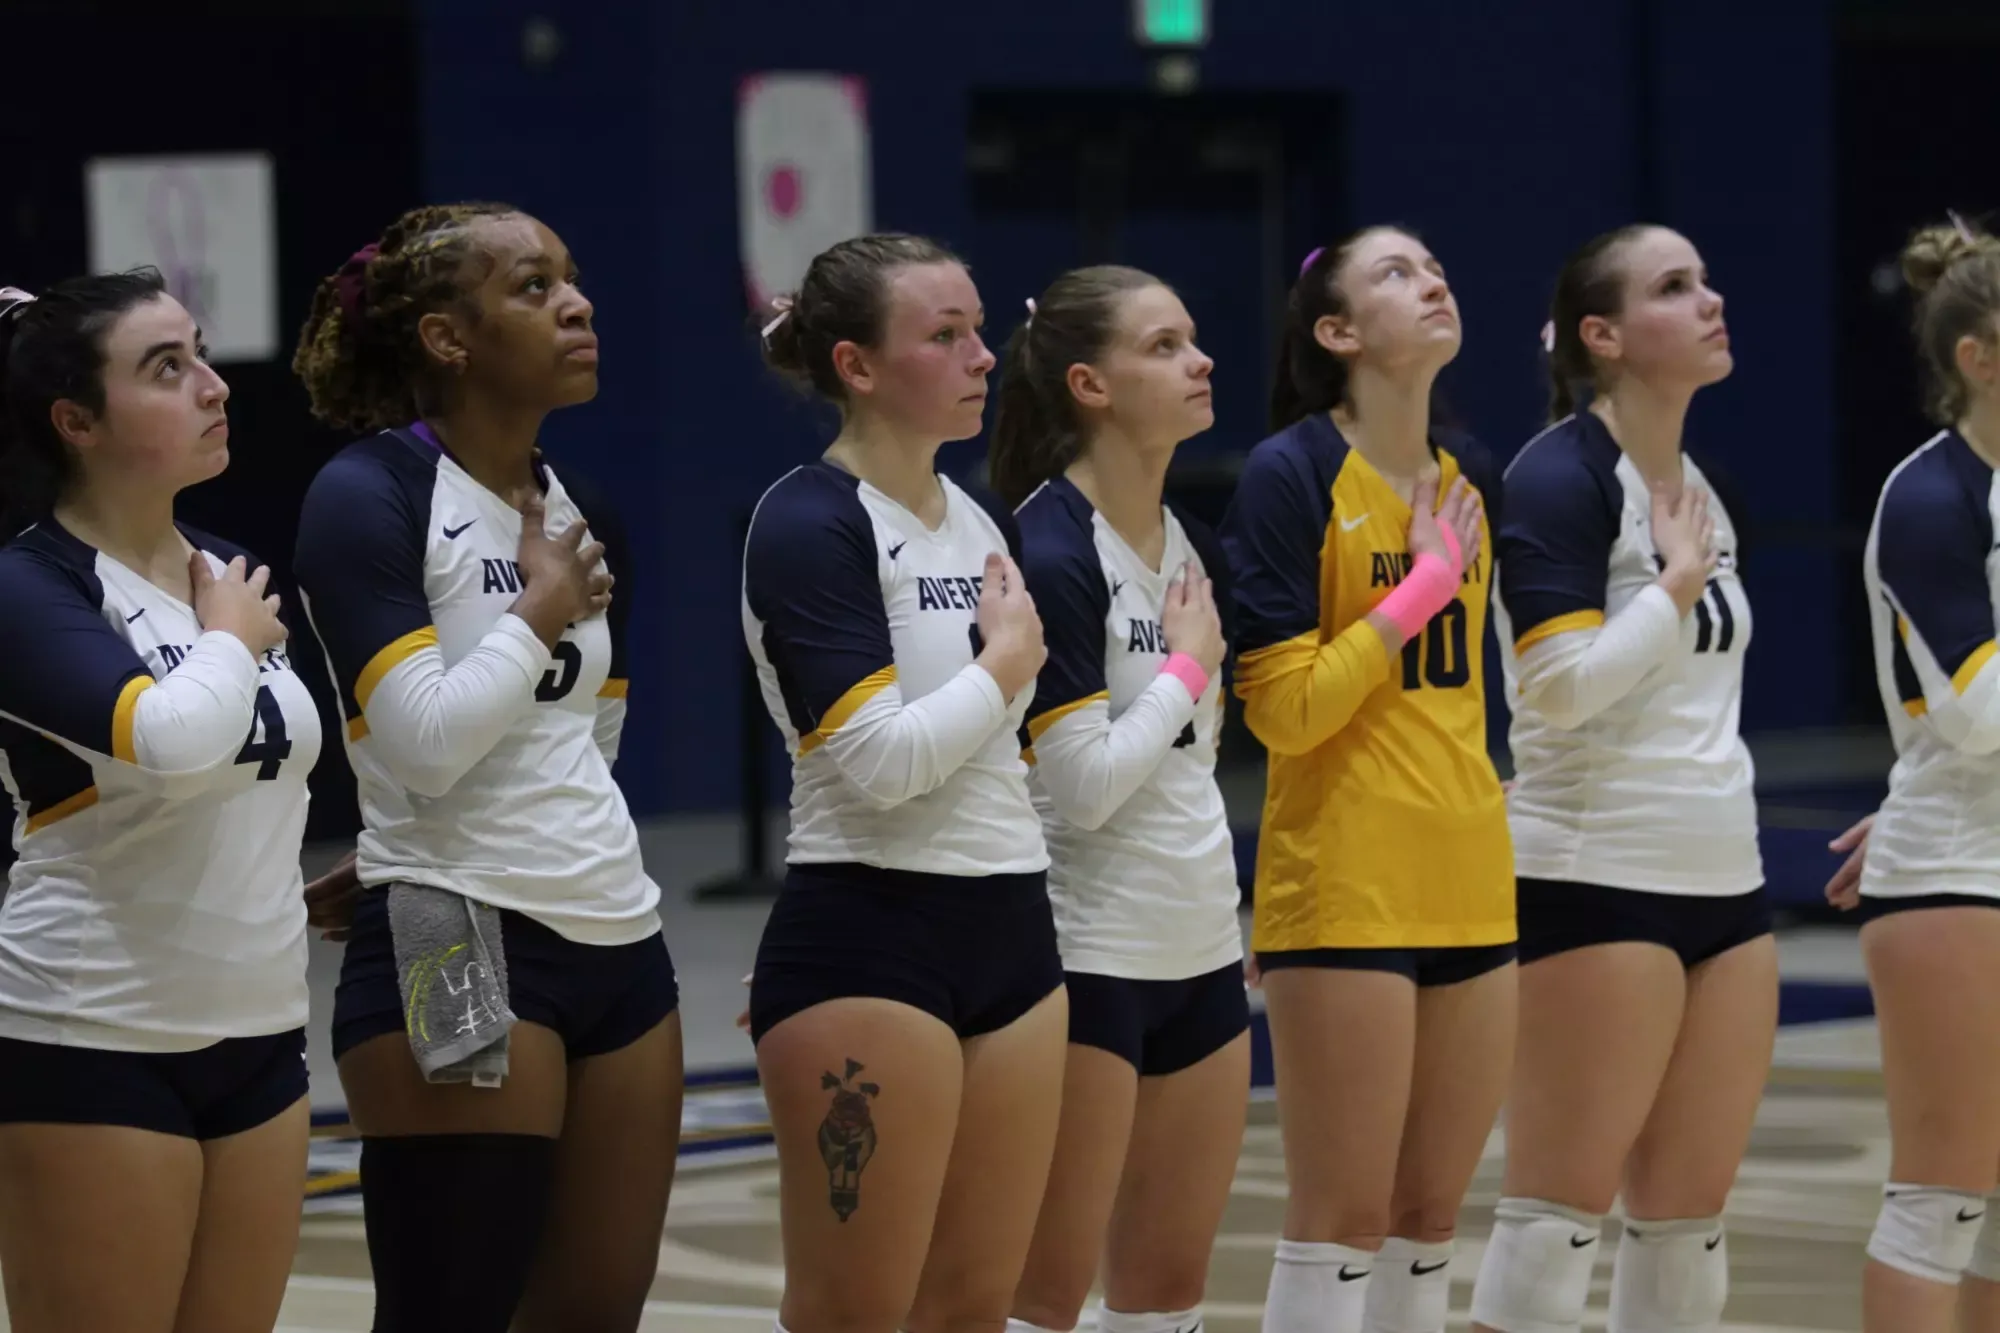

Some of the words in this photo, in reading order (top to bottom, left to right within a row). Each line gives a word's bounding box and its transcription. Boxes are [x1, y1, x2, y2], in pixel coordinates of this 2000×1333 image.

[1402, 597, 1471, 690] 10
[1694, 576, 1734, 654] 11
[234, 684, 293, 781] 4
